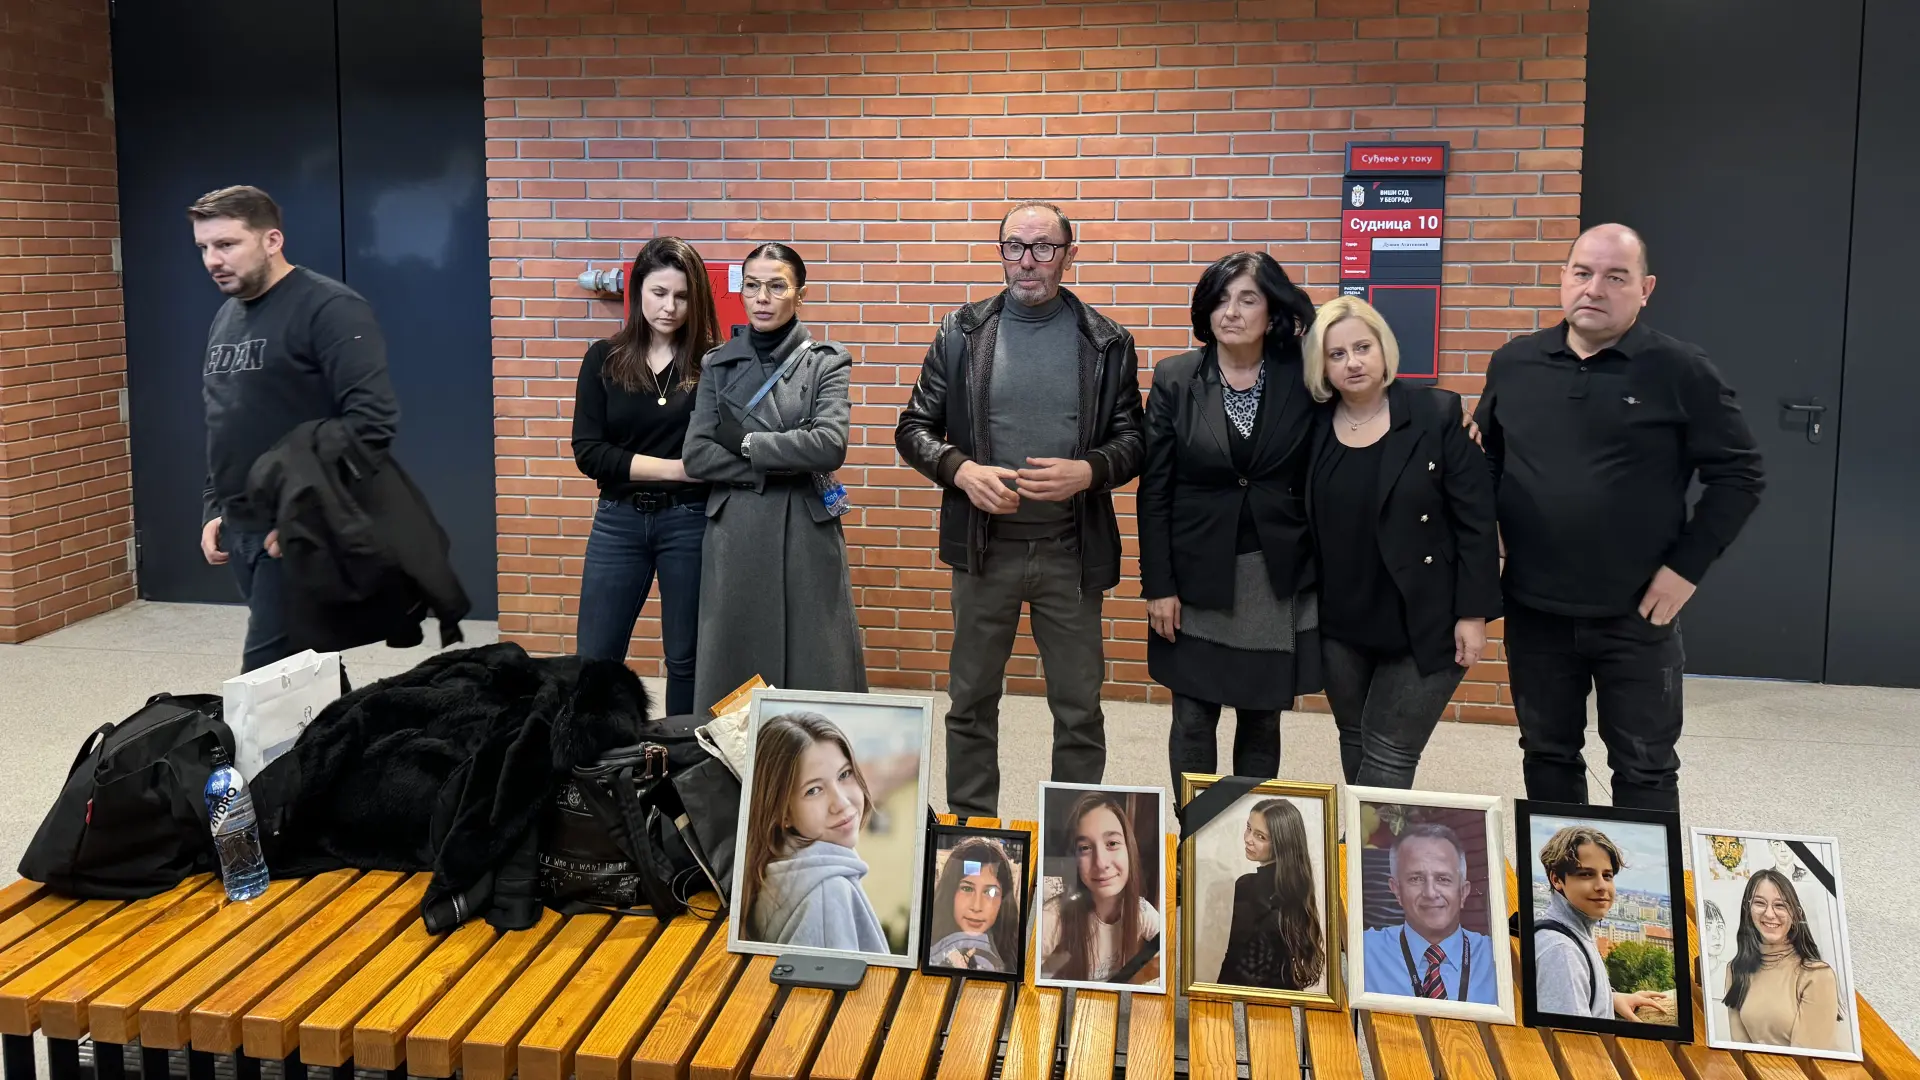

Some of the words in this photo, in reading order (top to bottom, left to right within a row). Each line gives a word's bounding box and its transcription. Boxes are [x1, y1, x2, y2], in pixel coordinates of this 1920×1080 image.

[1361, 154, 1399, 164] Суђење
[1402, 156, 1408, 165] у
[1411, 156, 1433, 164] току
[1350, 218, 1411, 232] Судница
[1418, 216, 1438, 230] 10
[211, 787, 237, 828] HYDRO
